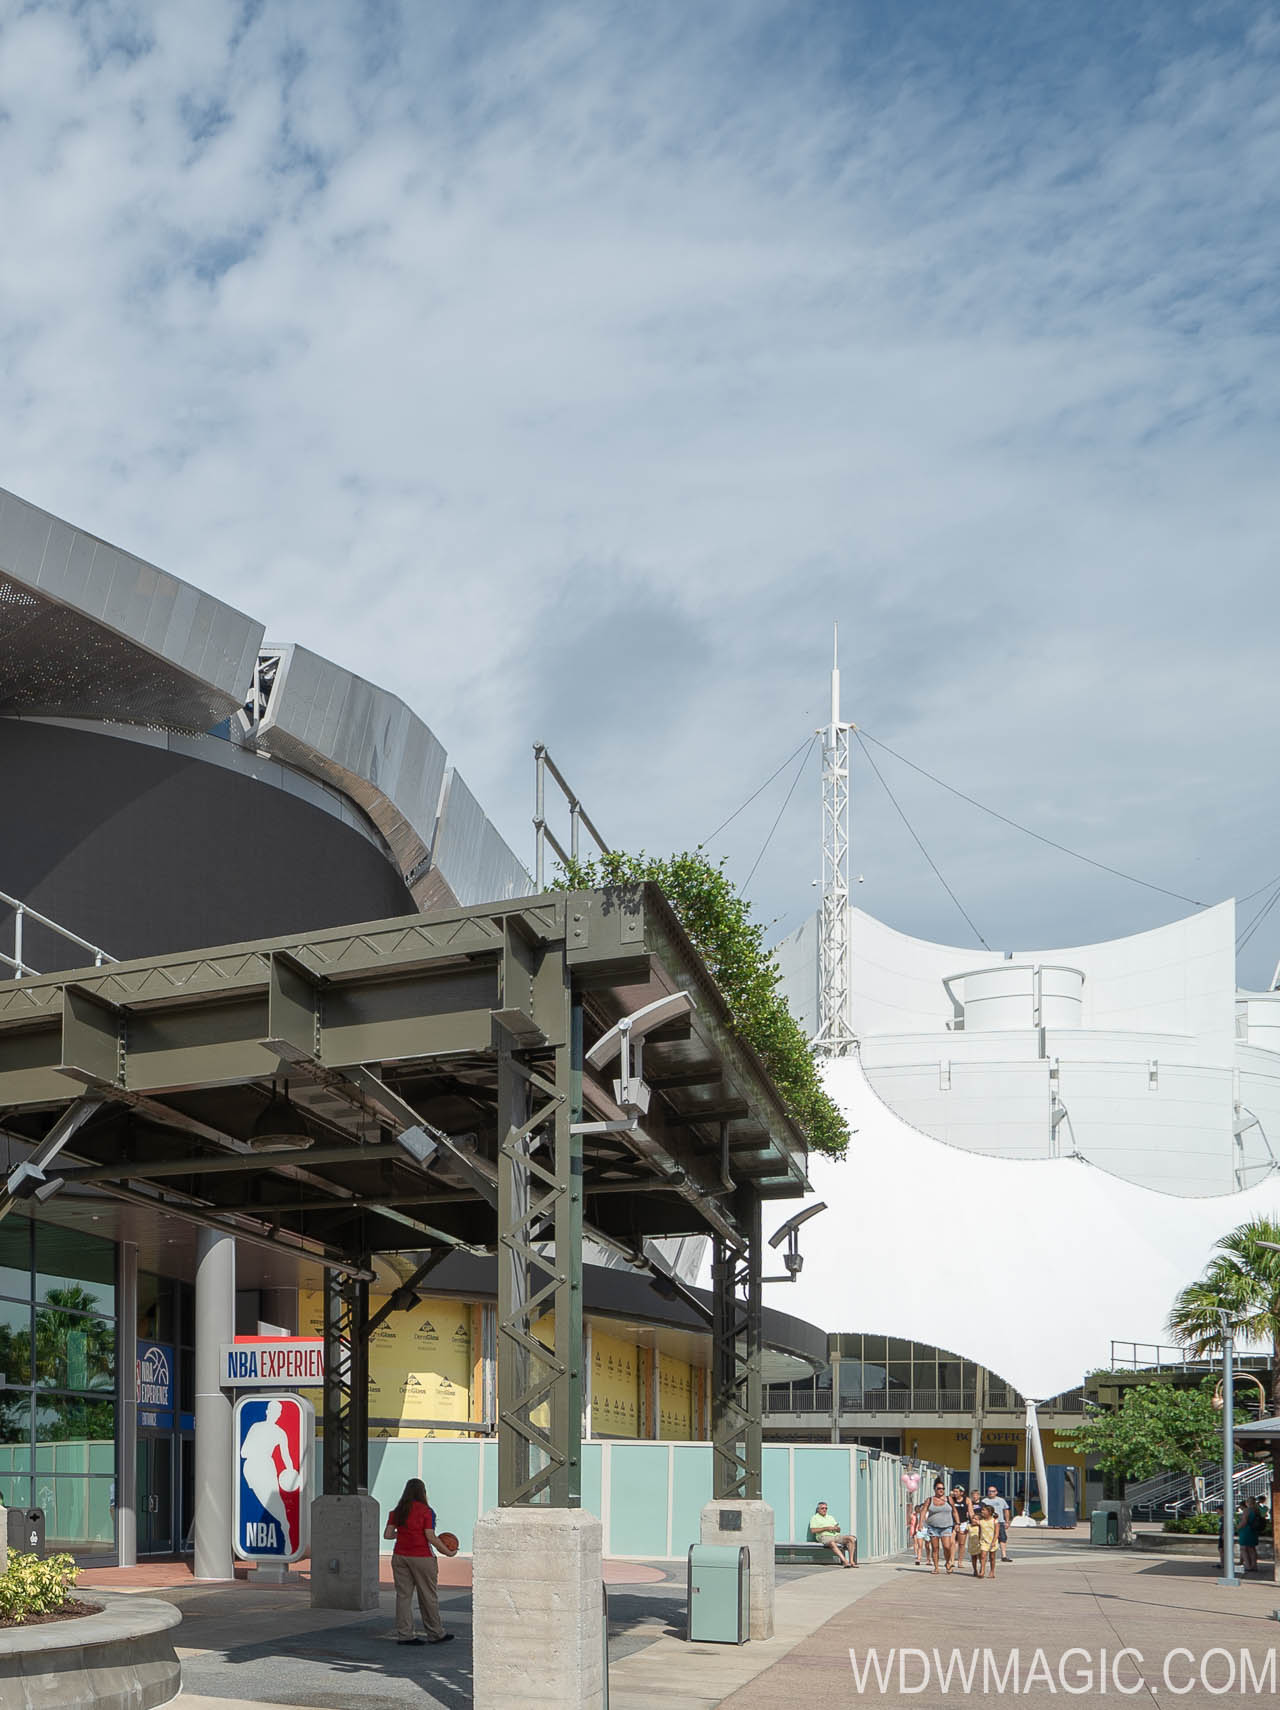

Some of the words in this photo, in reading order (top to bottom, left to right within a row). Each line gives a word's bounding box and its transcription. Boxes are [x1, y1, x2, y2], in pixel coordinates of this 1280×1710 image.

[142, 1361, 154, 1382] NBA
[228, 1351, 258, 1378] NBA
[261, 1349, 325, 1378] EXPERIEN
[141, 1384, 169, 1405] EXPERIENCE
[986, 1432, 1025, 1441] OFFIC
[246, 1522, 278, 1548] NBA
